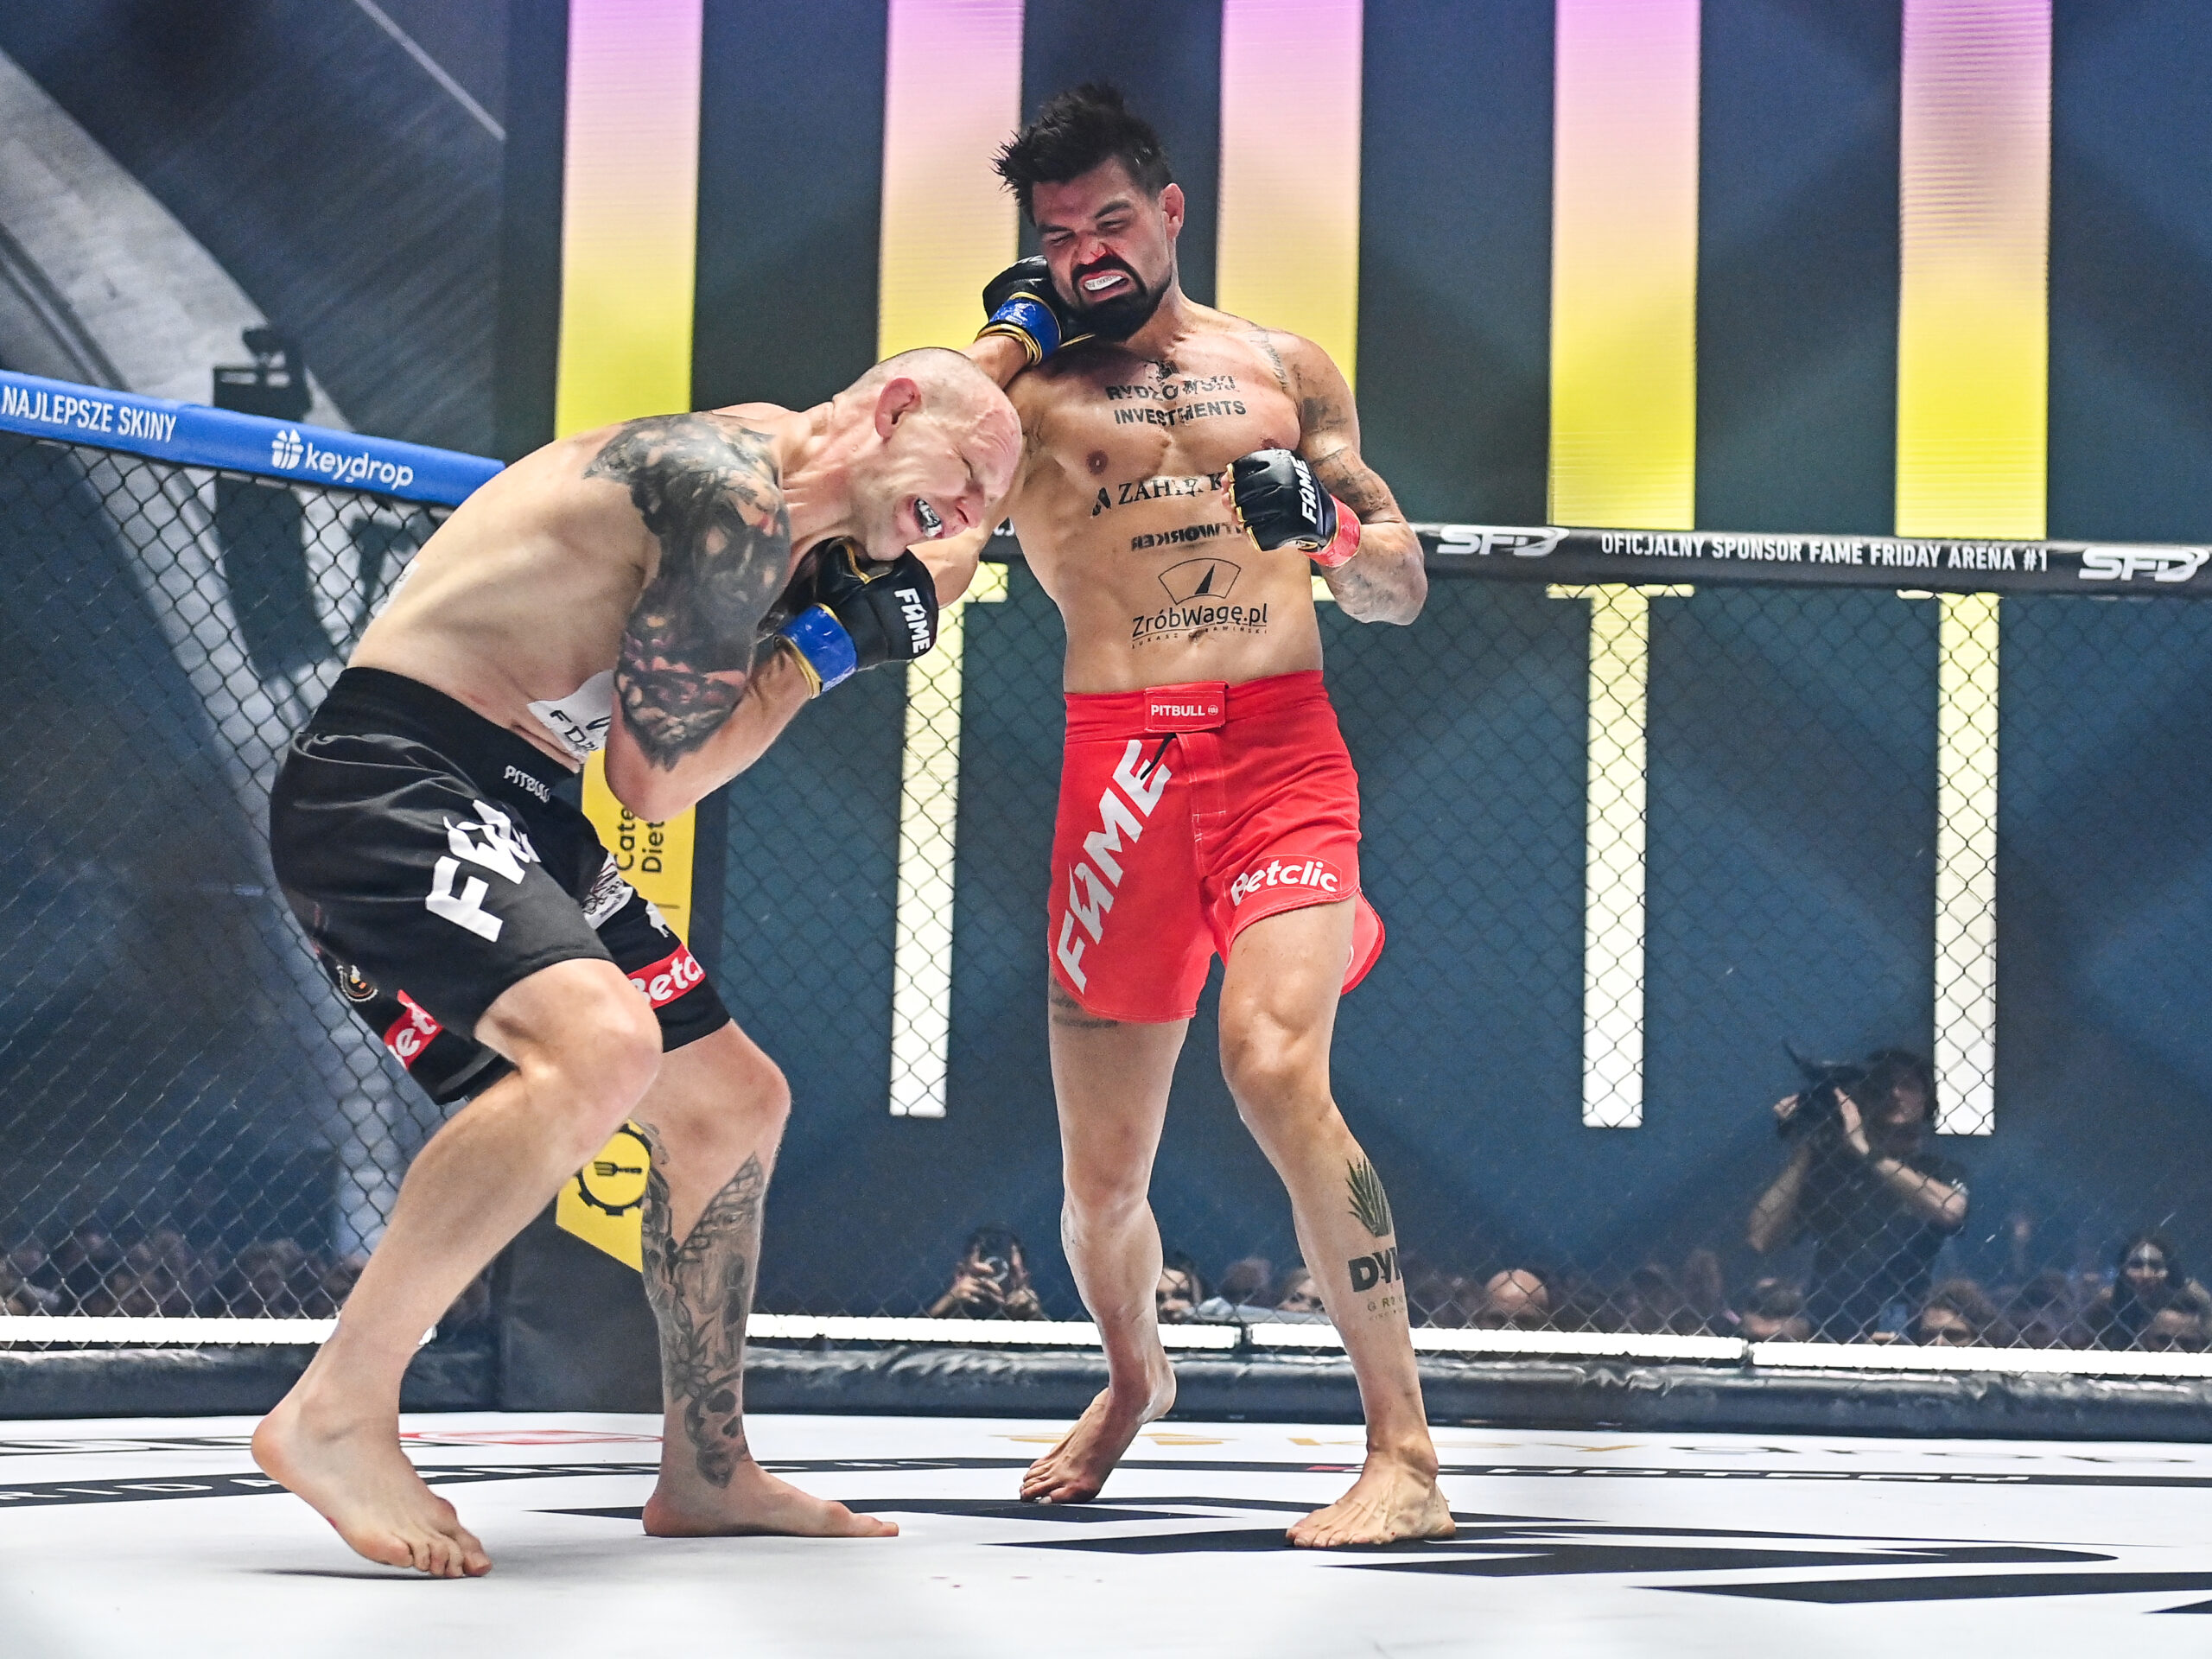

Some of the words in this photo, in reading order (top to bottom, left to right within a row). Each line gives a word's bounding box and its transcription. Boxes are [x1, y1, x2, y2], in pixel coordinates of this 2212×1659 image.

[2, 385, 114, 433] NAJLEPSZE
[118, 406, 177, 443] SKINY
[1114, 399, 1246, 426] INVESTMENTS
[304, 444, 414, 491] keydrop
[1289, 455, 1317, 524] FAME
[1436, 524, 1570, 557] SFD
[1601, 532, 1705, 558] OFICJALNY
[1711, 536, 1802, 563] SPONSOR
[1809, 541, 1863, 566] FAME
[1870, 543, 1942, 569] FRIDAY
[1948, 546, 2016, 571] ARENA
[2023, 548, 2048, 572] #1
[2078, 546, 2210, 582] SFD
[894, 588, 931, 653] FAME
[1132, 603, 1267, 638] ZróbWagę.pl
[1151, 704, 1205, 716] PITBULL
[614, 808, 635, 871] Cate
[641, 821, 664, 873] Diet
[1057, 739, 1173, 995] FAME
[1230, 859, 1338, 906] Betclic
[1486, 1468, 2029, 1482] HOTPAY
